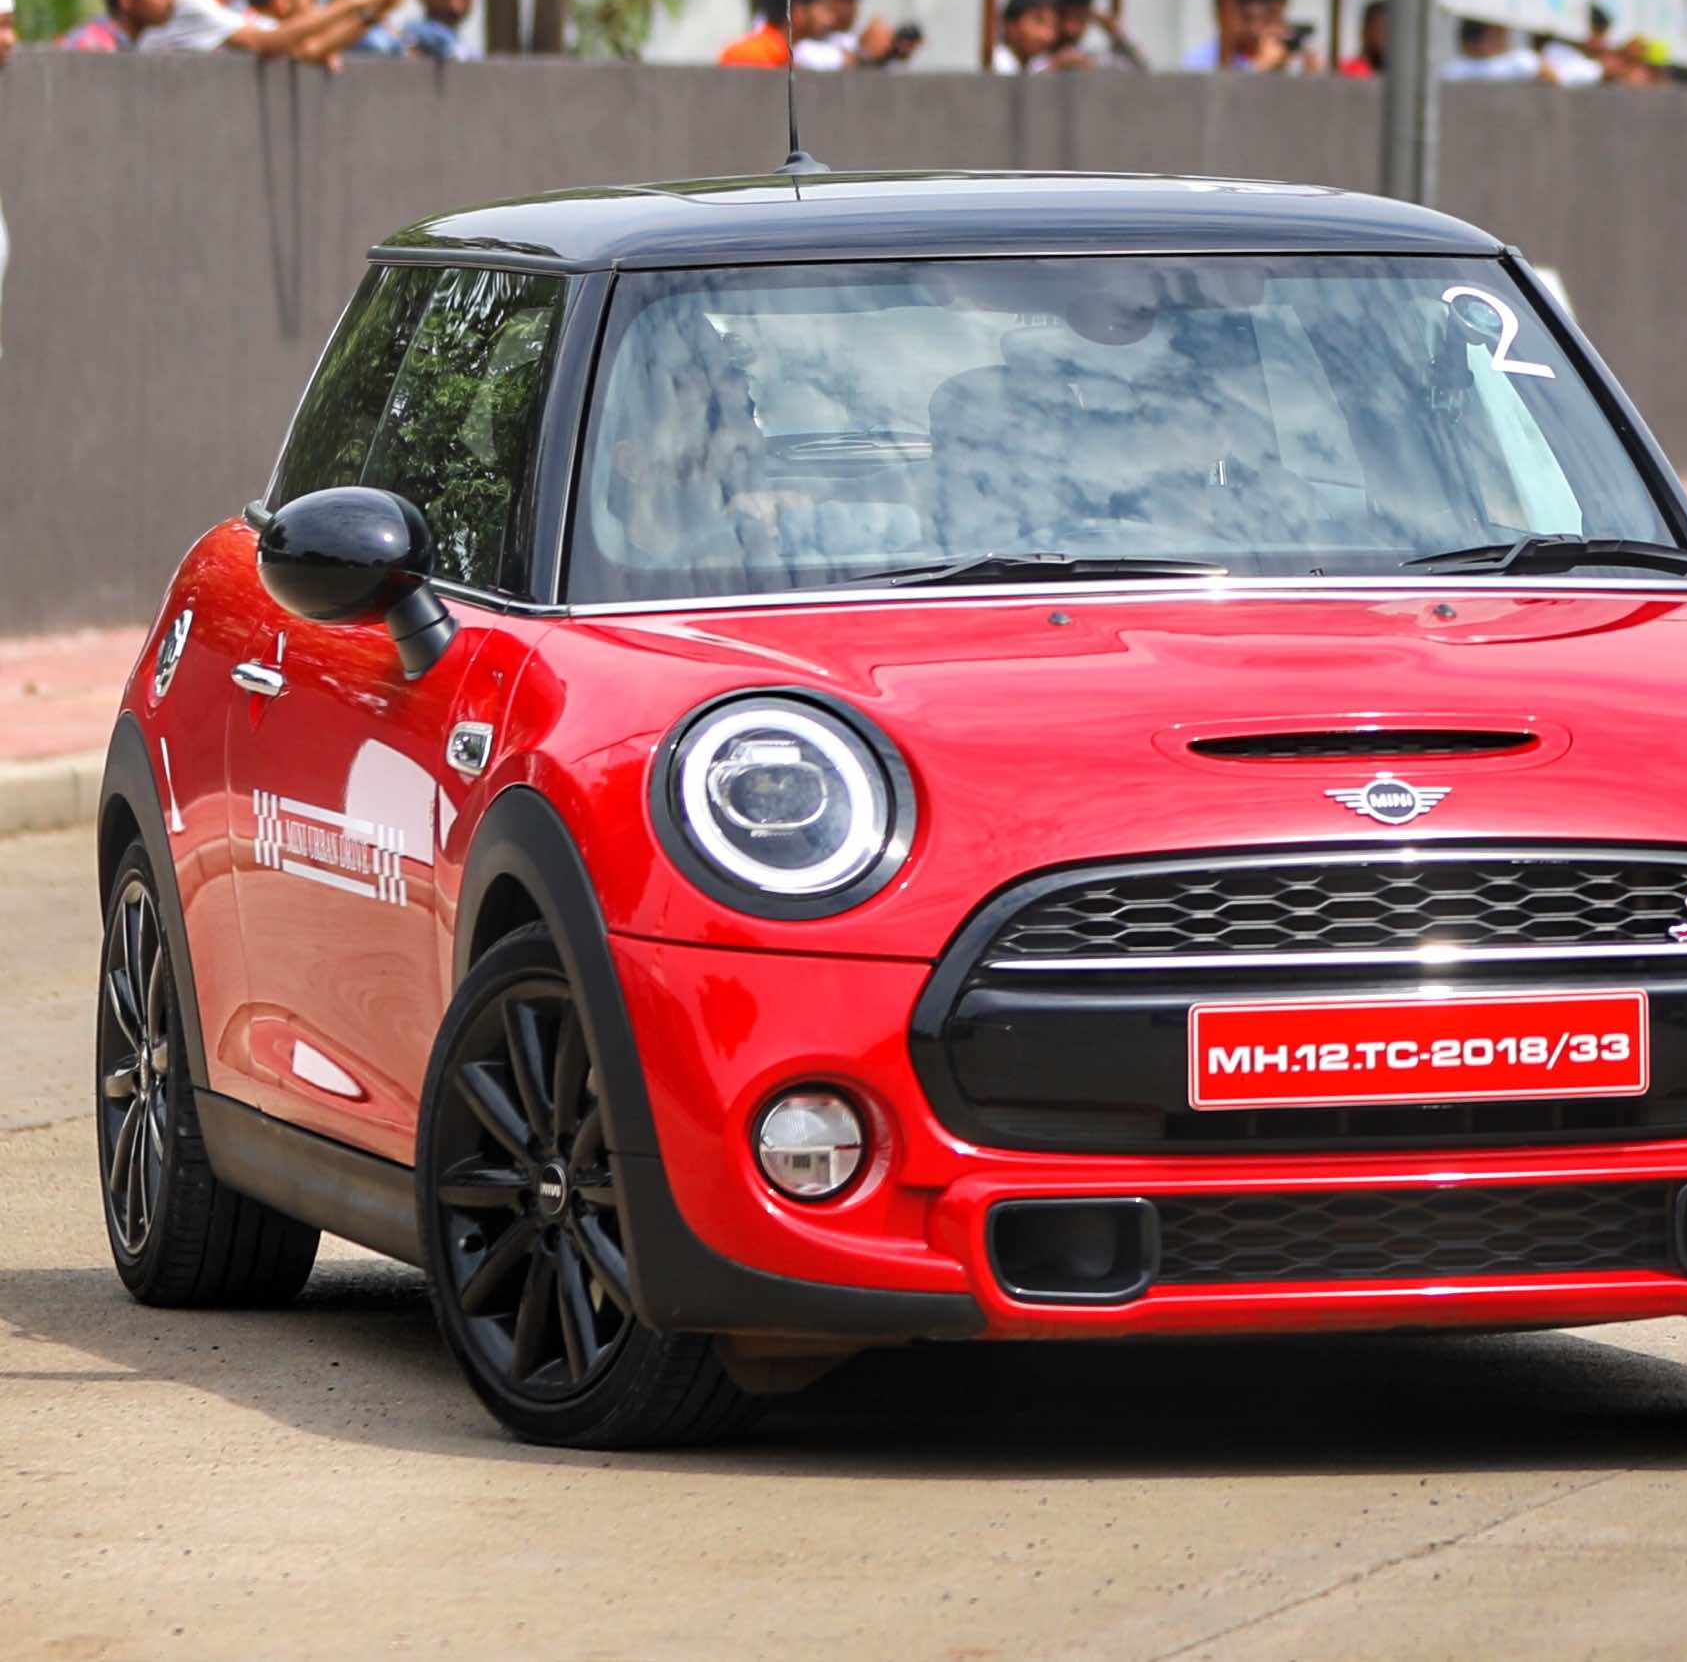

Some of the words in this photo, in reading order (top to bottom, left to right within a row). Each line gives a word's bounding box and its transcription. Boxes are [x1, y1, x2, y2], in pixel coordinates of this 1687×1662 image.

[1441, 286, 1556, 379] 2
[1369, 792, 1413, 809] MINI
[1207, 1031, 1631, 1076] MH.12.TC-2018/33
